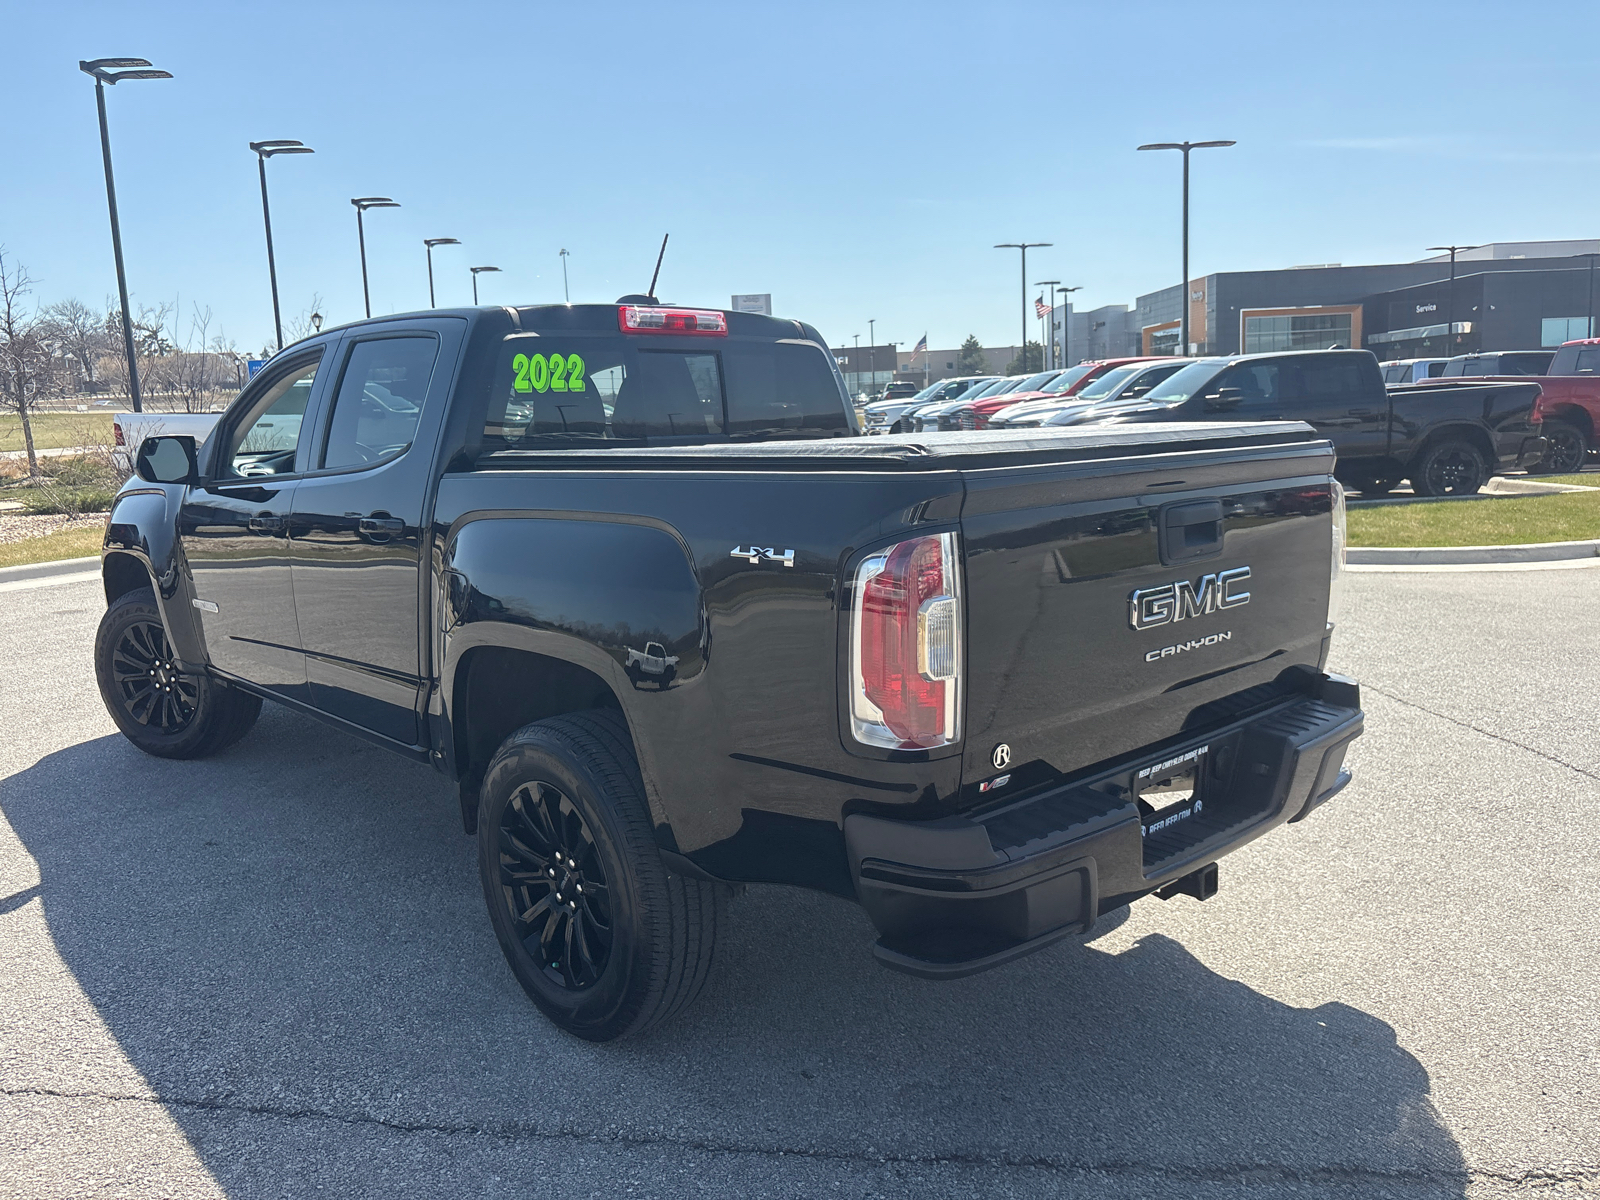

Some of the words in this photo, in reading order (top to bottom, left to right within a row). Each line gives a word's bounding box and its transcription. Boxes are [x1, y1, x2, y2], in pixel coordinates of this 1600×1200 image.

[1415, 303, 1437, 314] Service
[512, 353, 586, 393] 2022
[1128, 565, 1251, 631] GMC
[1144, 631, 1232, 663] CANYON
[1139, 768, 1151, 779] REED
[1162, 755, 1184, 770] CHRYSLER
[1198, 745, 1209, 756] RAM
